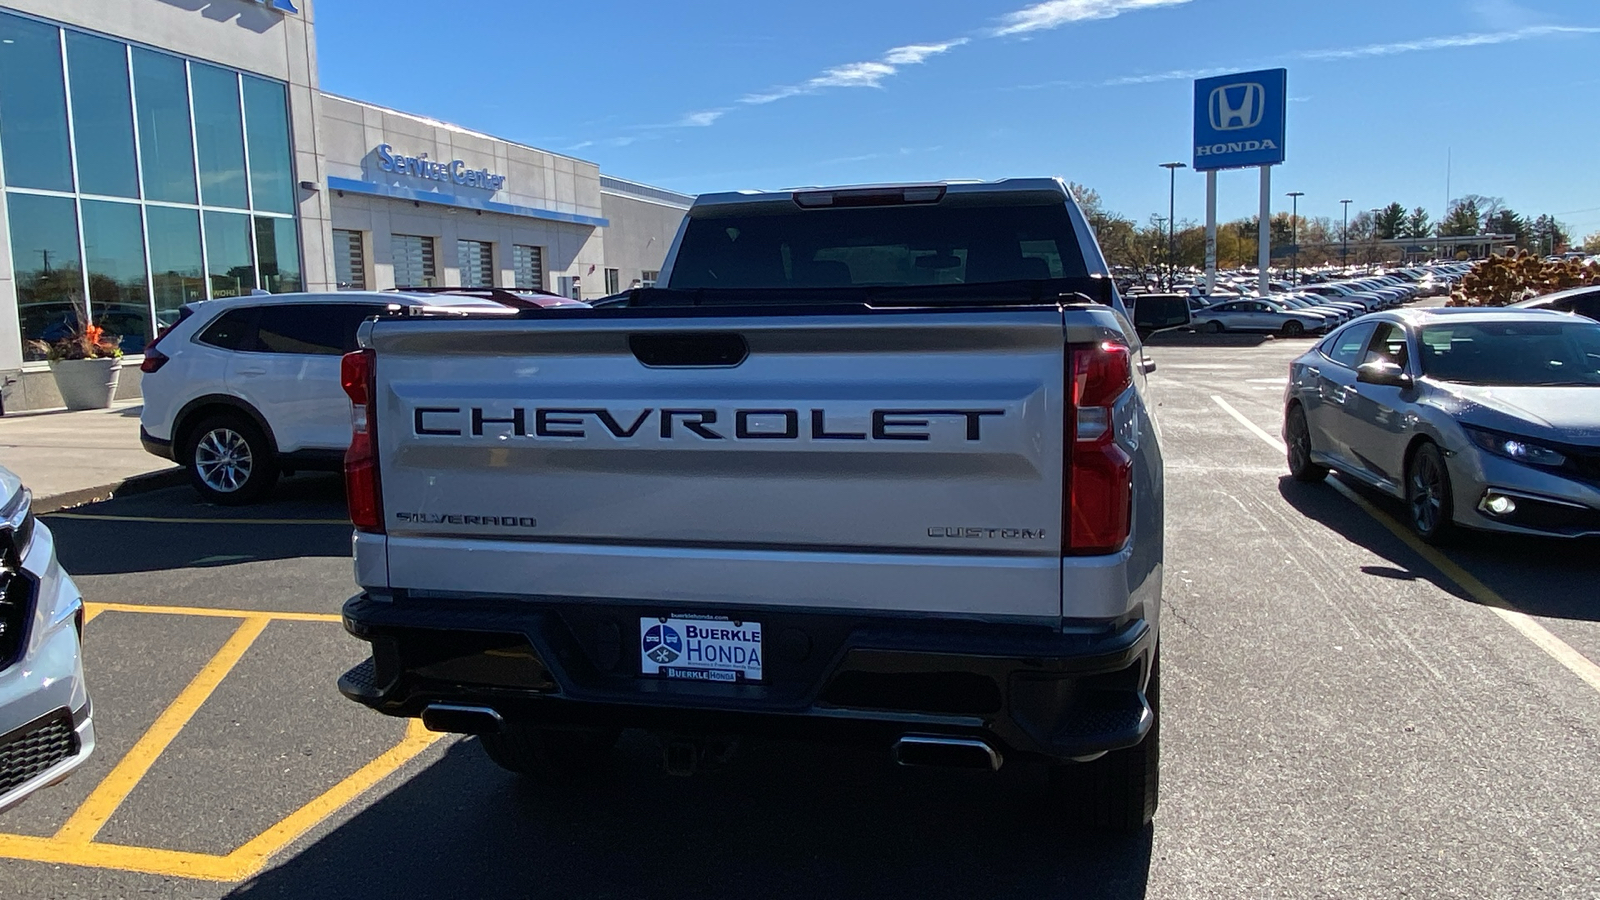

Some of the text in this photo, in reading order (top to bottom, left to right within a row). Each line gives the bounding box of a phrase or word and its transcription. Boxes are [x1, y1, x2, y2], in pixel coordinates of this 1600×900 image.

[1196, 139, 1278, 156] HONDA
[377, 143, 506, 191] Service Center
[413, 407, 1006, 442] CHEVROLET
[396, 512, 537, 528] SILVERADO
[927, 526, 1046, 539] CUSTOM
[685, 625, 760, 643] BUERKLE
[686, 639, 760, 666] HONDA
[668, 668, 735, 680] BUERKLE HONDA
